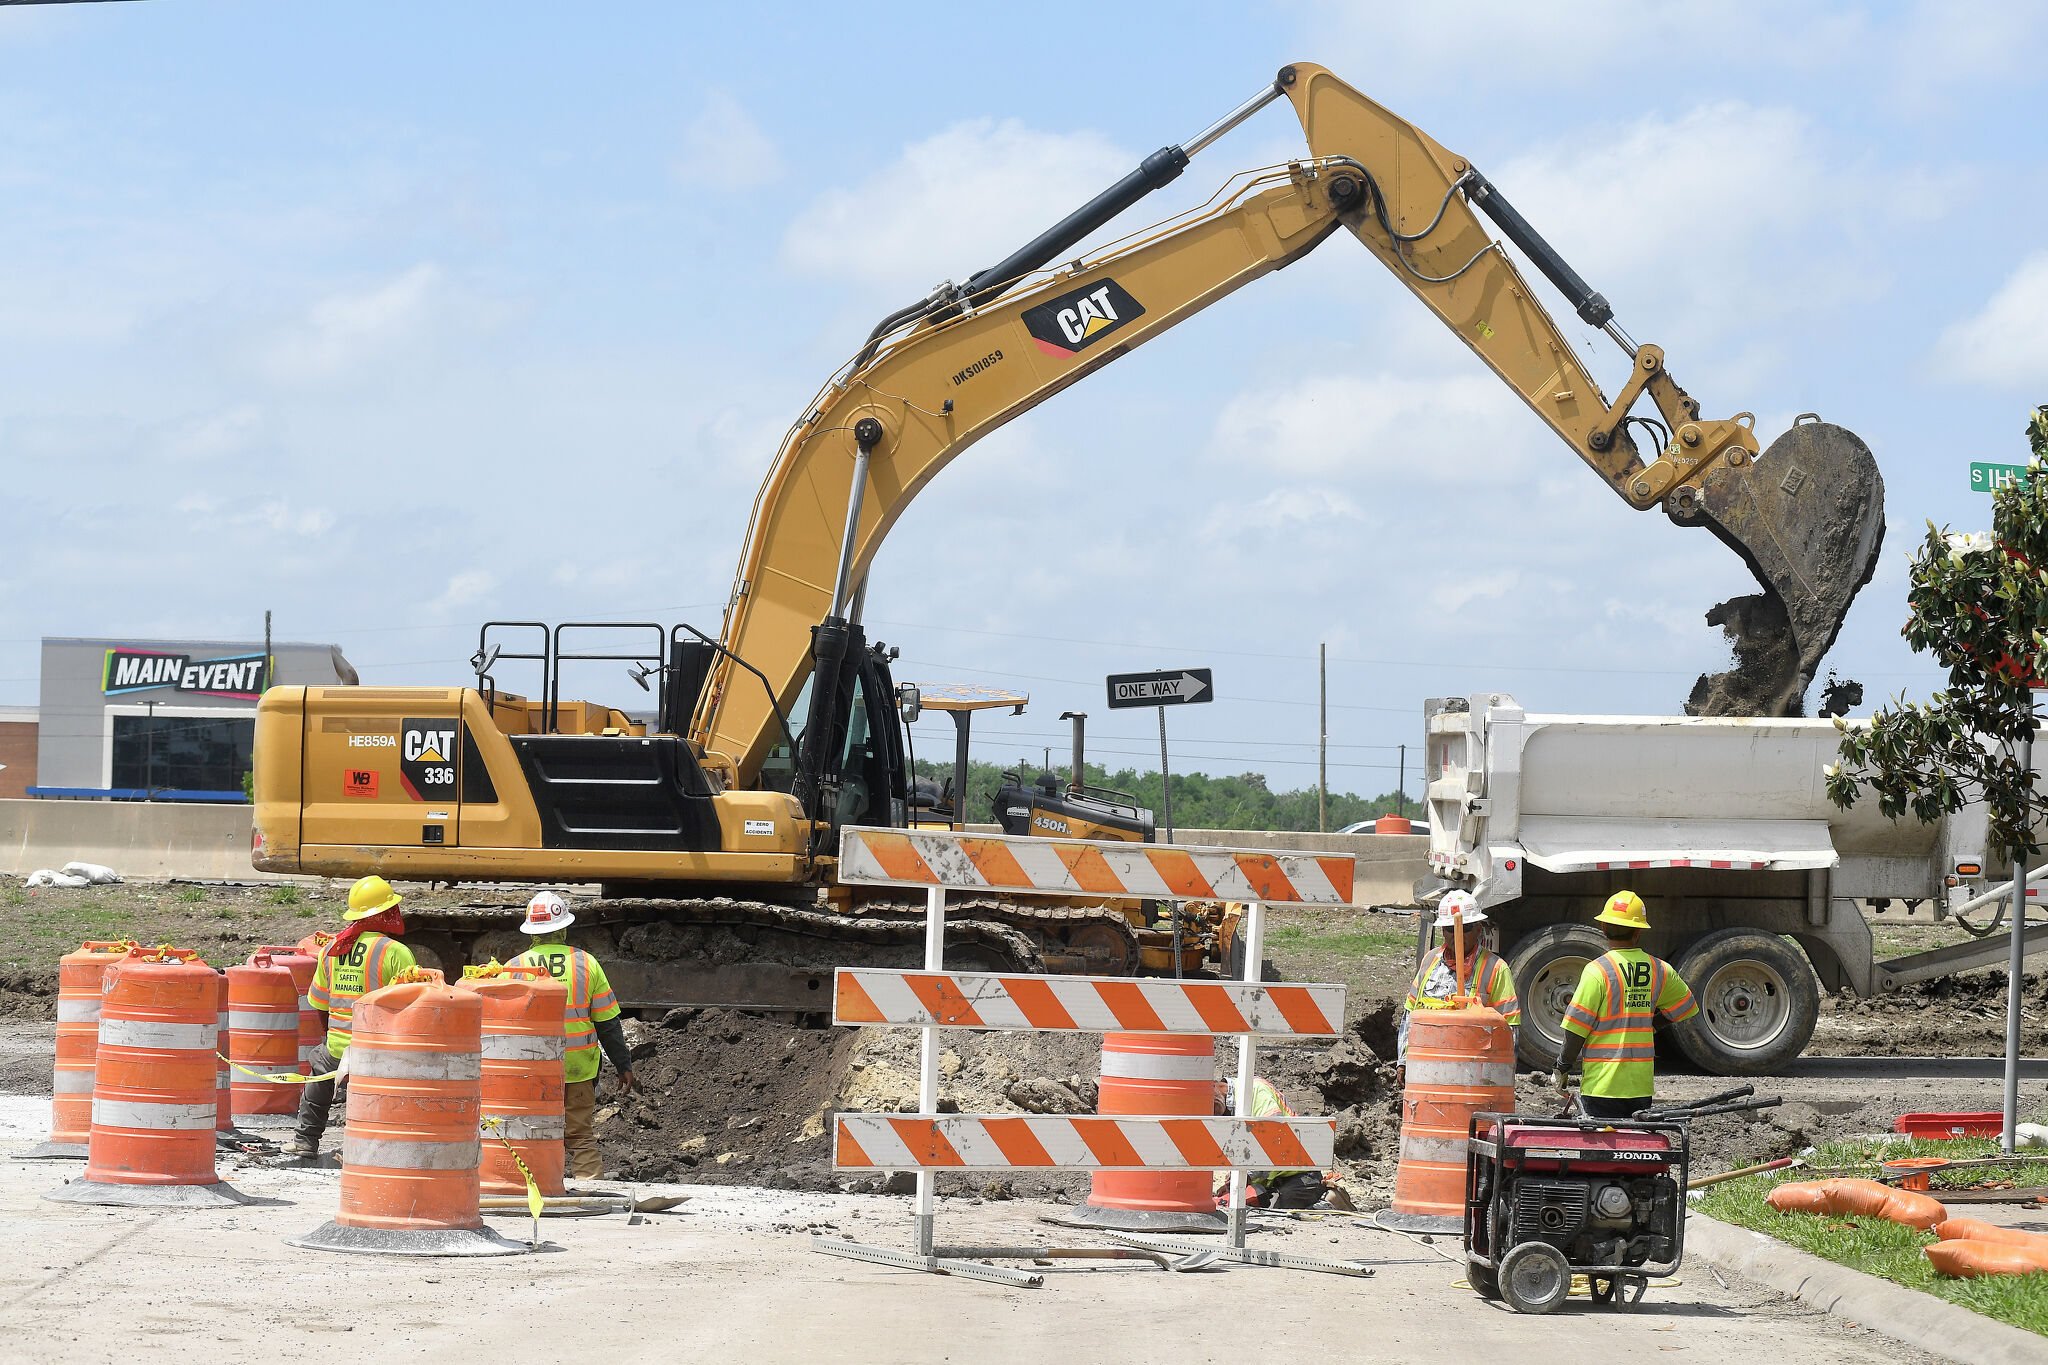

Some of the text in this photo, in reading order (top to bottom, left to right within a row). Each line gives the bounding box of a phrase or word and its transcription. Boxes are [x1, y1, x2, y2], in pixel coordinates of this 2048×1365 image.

[1056, 285, 1119, 344] CAT
[952, 349, 1004, 386] DKS01859
[1972, 468, 1983, 483] S
[115, 657, 263, 690] MAIN EVENT
[1118, 681, 1180, 698] ONE WAY
[348, 735, 397, 747] HE859A
[404, 729, 456, 762] CAT
[353, 771, 370, 785] WB
[424, 767, 454, 784] 336
[1033, 816, 1067, 833] 450H
[339, 973, 359, 982] SAFETY
[1618, 961, 1651, 988] WB
[335, 983, 364, 993] MANAGER
[1613, 1151, 1662, 1161] HONDA
